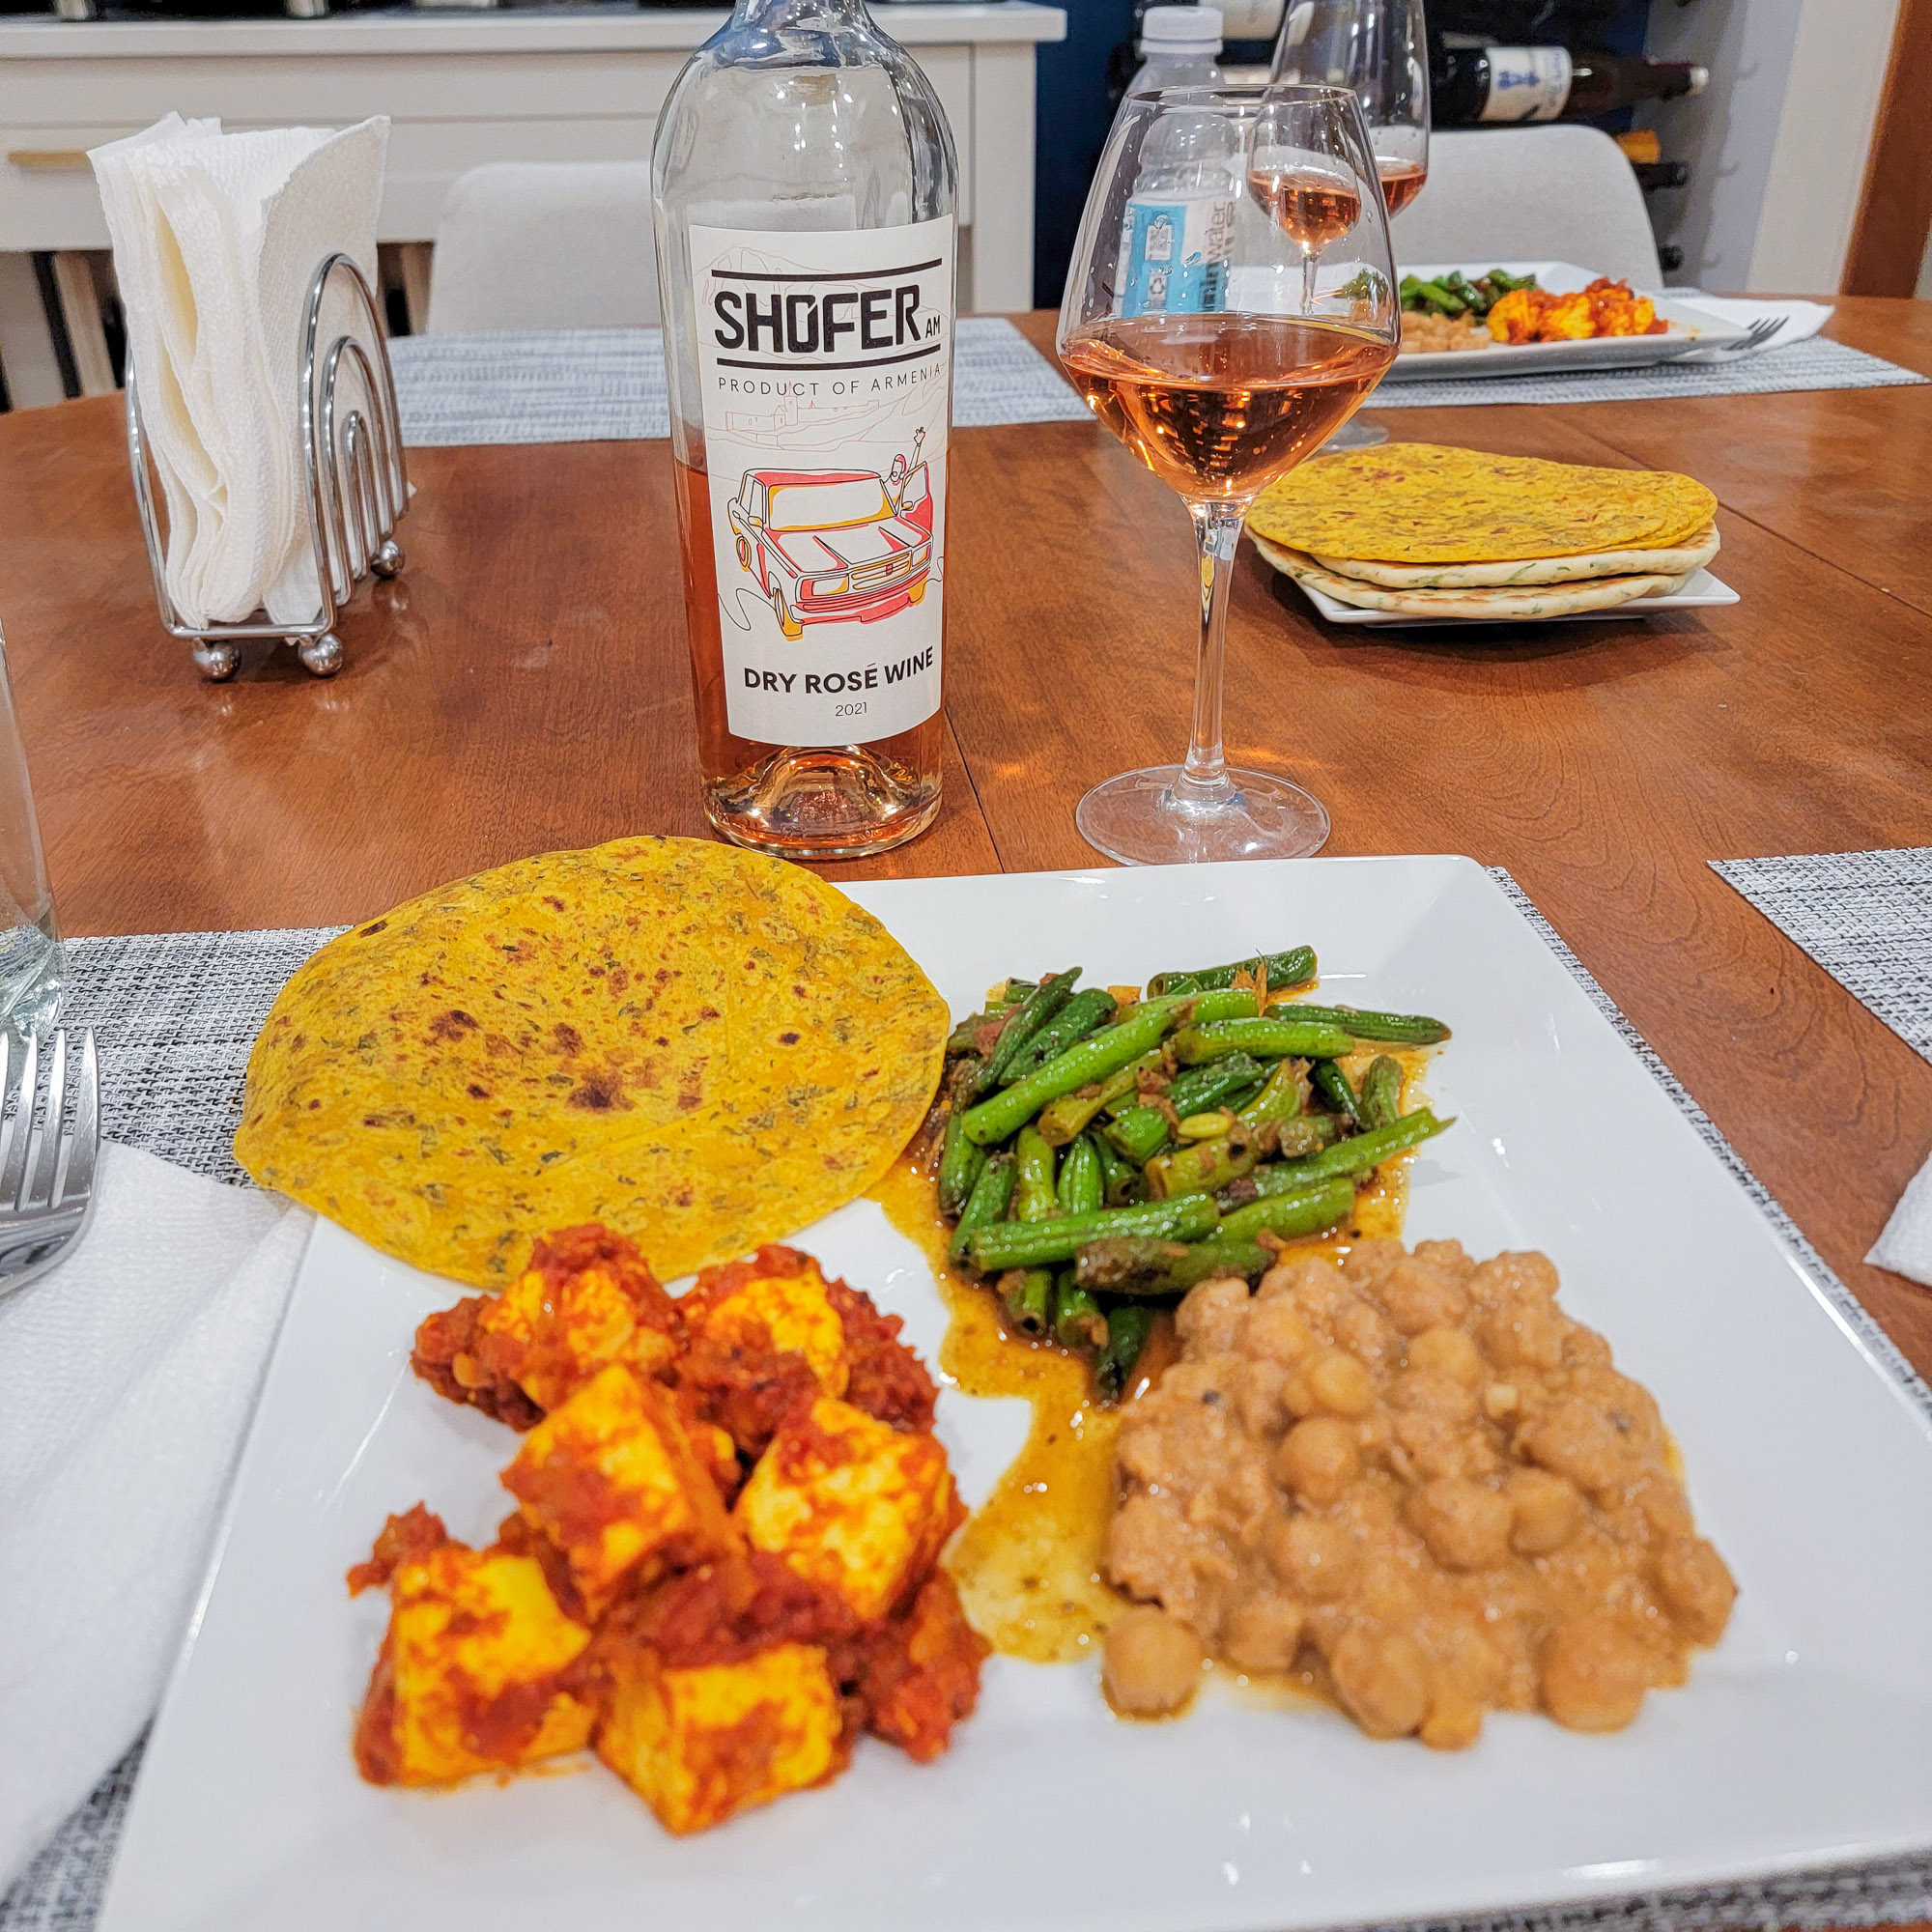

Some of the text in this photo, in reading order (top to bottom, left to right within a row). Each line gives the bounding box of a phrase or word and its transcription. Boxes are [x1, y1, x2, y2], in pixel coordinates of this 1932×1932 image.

[714, 284, 941, 354] SHOFER AM
[718, 362, 942, 397] PRODUCT OF ARMENIA
[743, 644, 934, 695] DRY ROSÉ WINE
[835, 700, 868, 718] 2021
